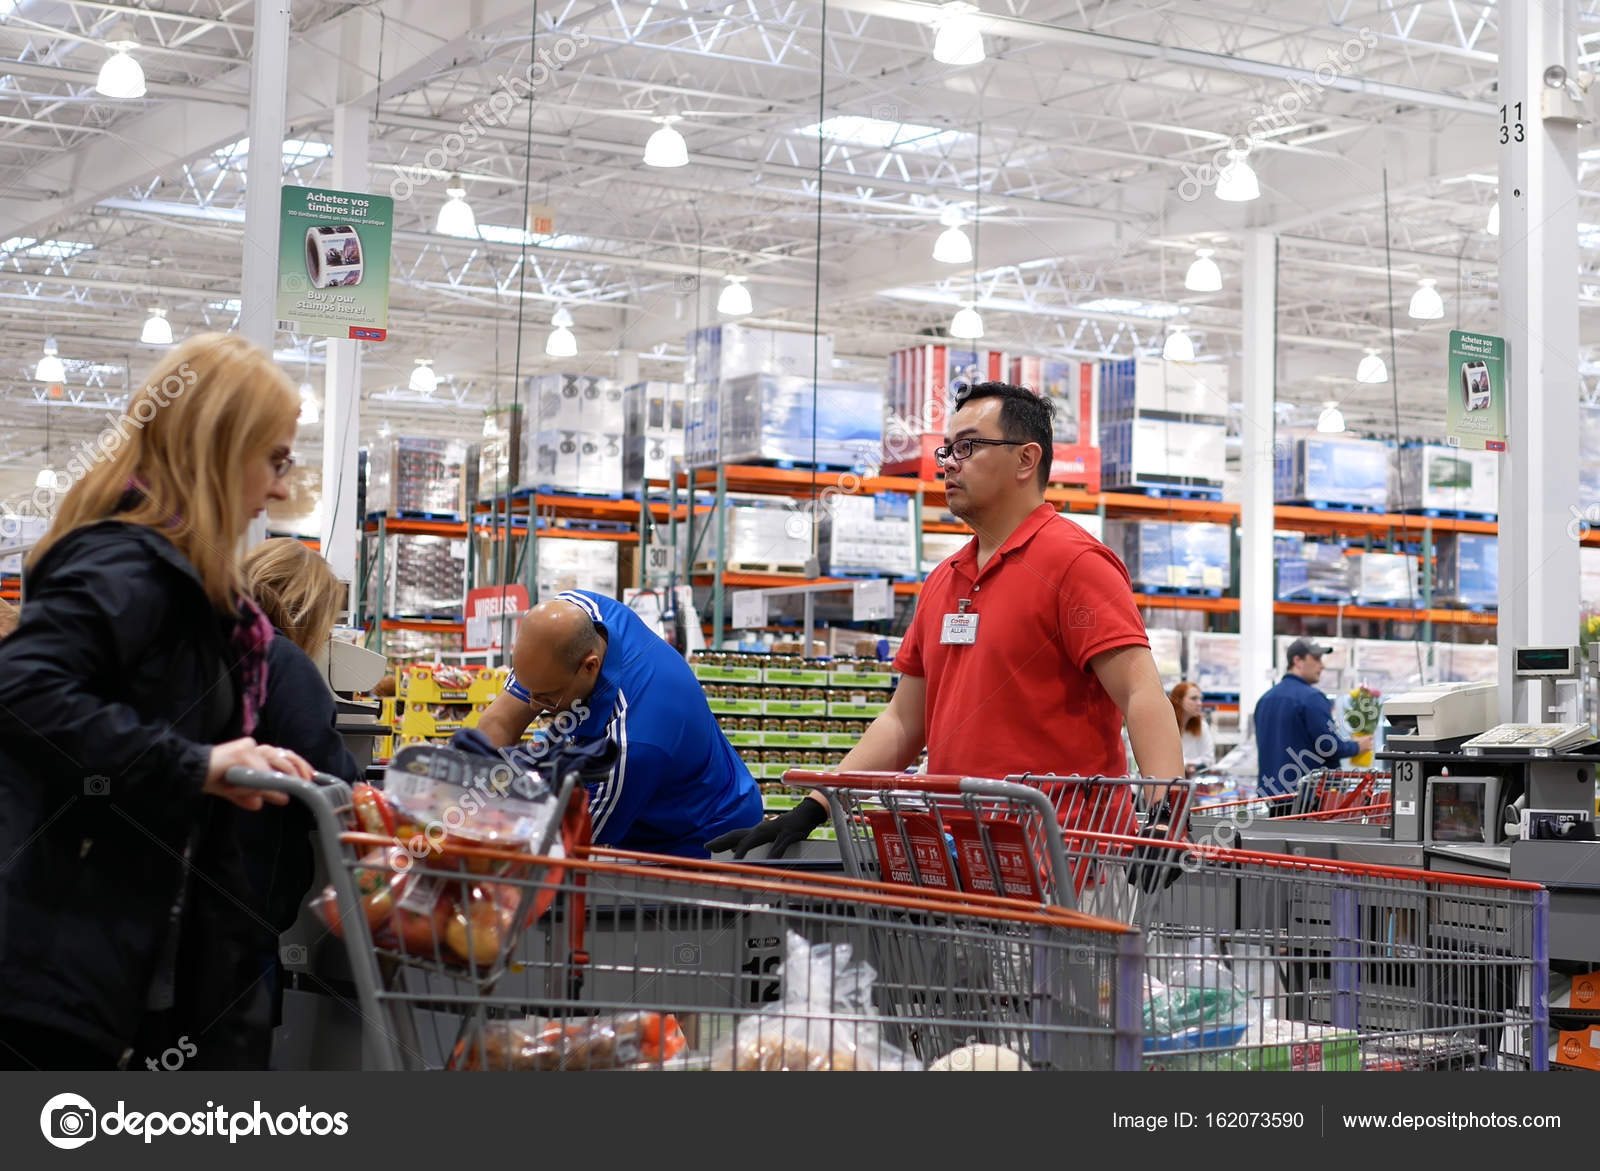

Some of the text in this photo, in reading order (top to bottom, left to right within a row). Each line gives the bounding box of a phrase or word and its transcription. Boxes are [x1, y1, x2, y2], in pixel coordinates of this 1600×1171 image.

[307, 192, 369, 207] Achetez vos
[308, 203, 367, 217] timbres ici!
[308, 291, 355, 304] Buy your
[296, 300, 367, 314] stamps here!
[649, 548, 668, 568] 301
[1397, 762, 1413, 782] 13
[742, 956, 780, 1003] 12
